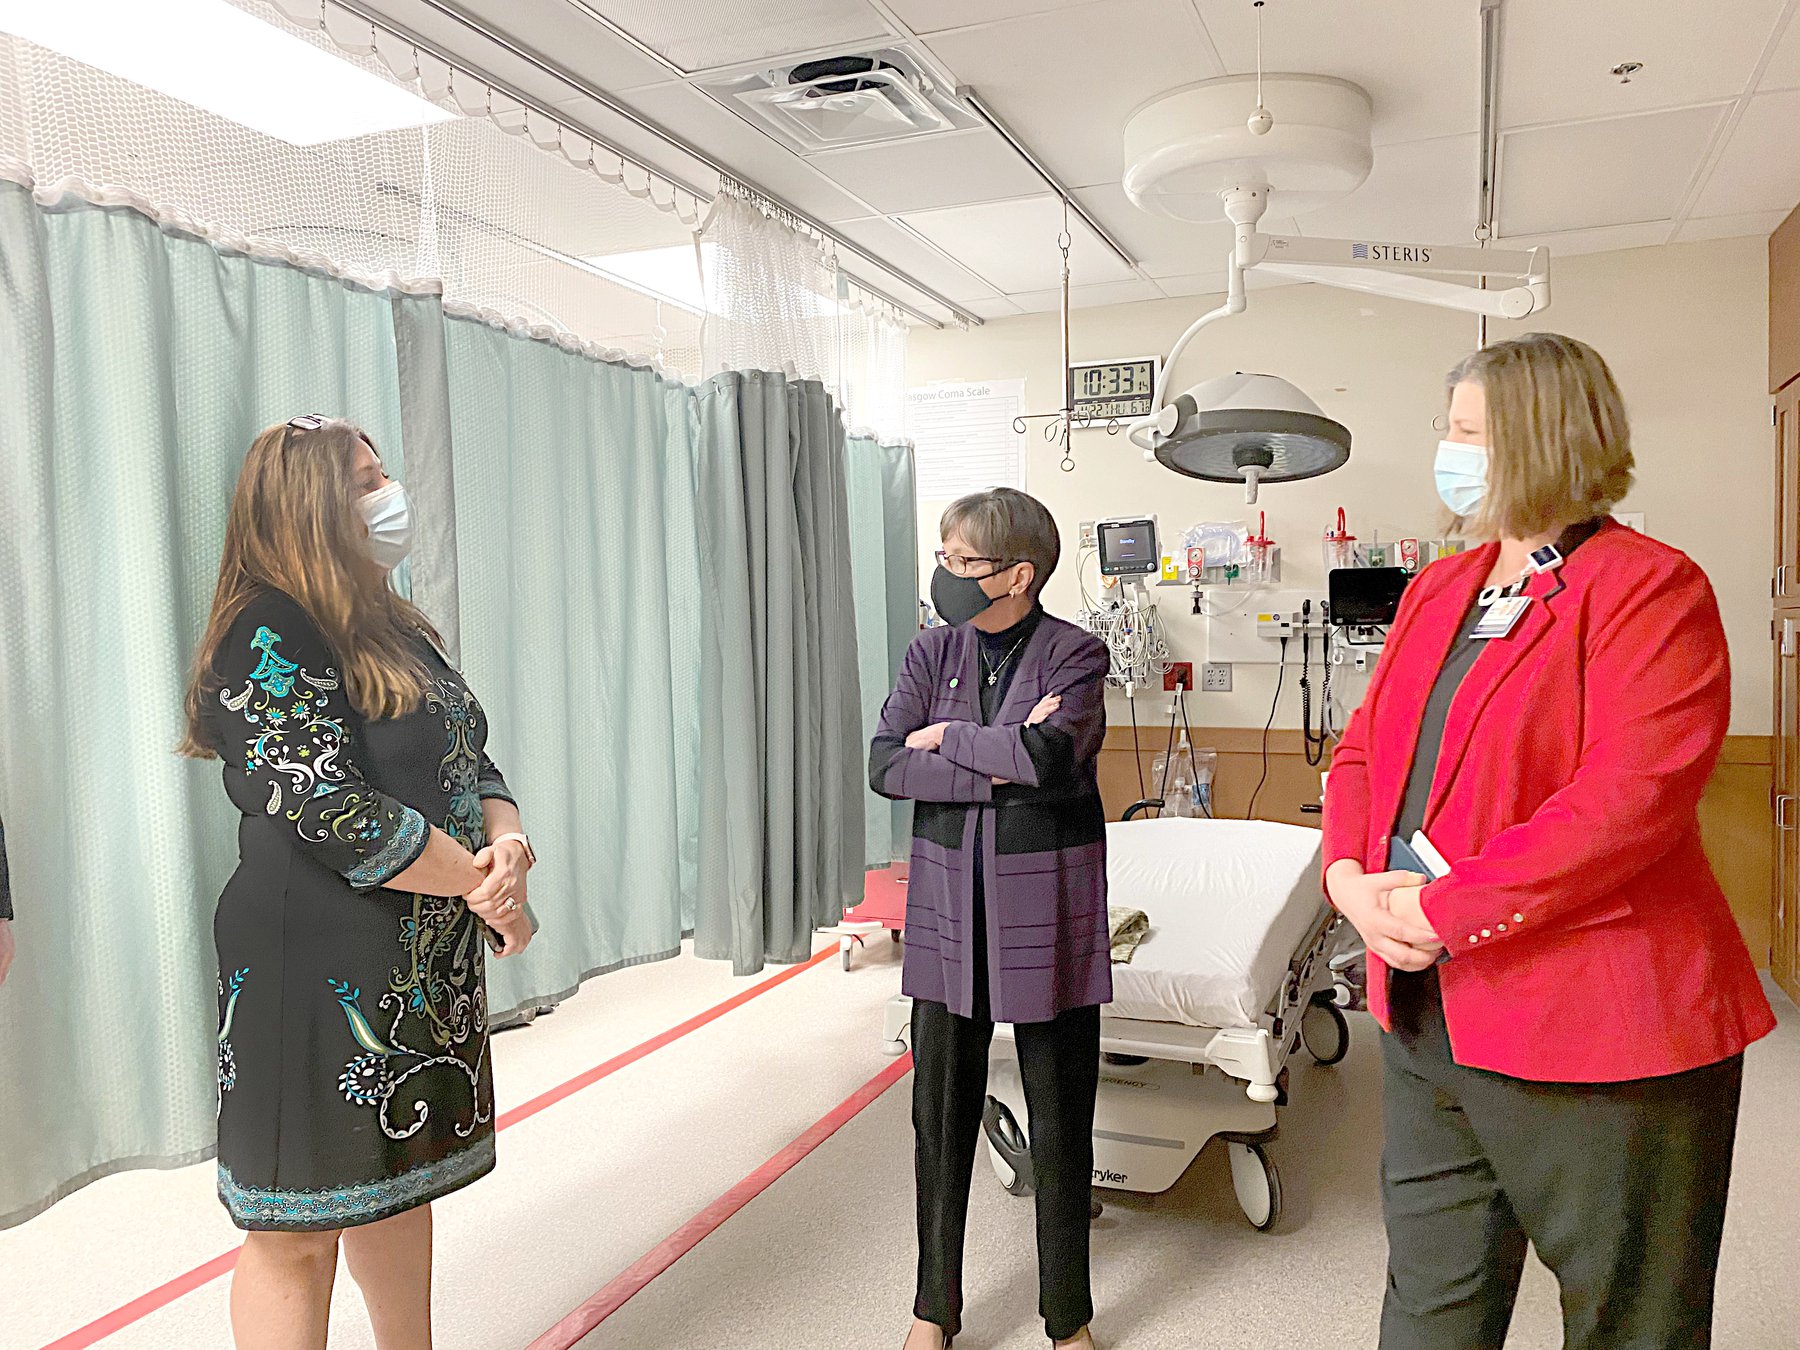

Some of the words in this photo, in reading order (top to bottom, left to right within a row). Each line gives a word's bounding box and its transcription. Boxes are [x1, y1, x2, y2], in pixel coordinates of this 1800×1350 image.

[1372, 245, 1430, 262] STERIS
[1083, 366, 1134, 396] 10:33
[907, 391, 936, 403] asgow
[938, 389, 964, 400] Coma
[966, 386, 990, 397] Scale
[1093, 1169, 1128, 1183] ryker
